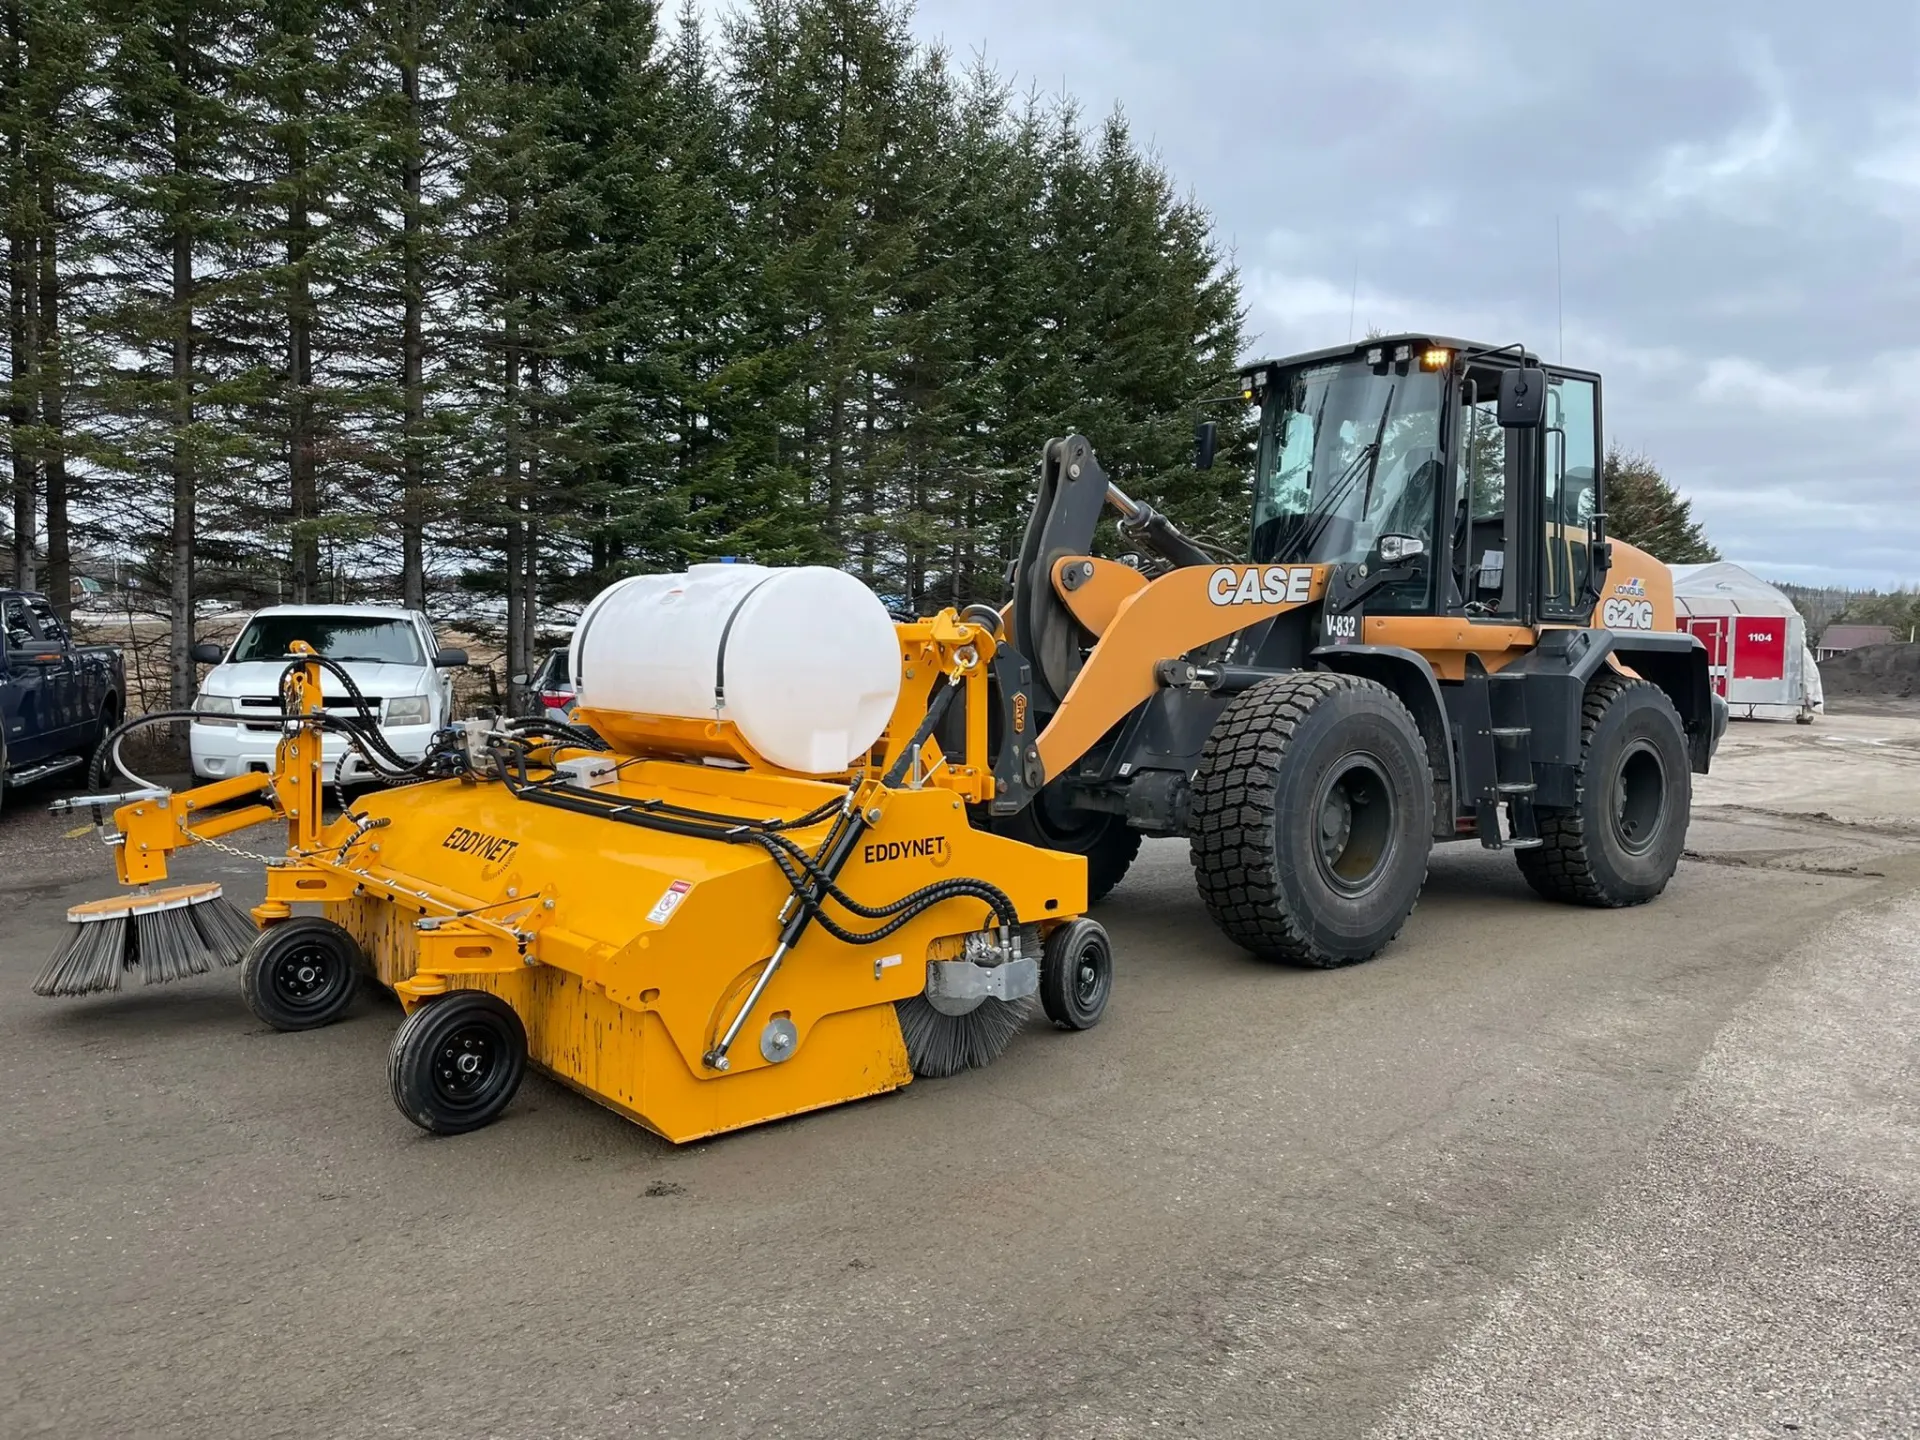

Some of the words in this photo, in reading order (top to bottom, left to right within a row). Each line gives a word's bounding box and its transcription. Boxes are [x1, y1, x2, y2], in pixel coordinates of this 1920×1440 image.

[1207, 566, 1313, 606] CASE
[1614, 585, 1645, 596] LONGUS
[1326, 614, 1356, 637] V-832
[1603, 597, 1653, 630] 621G
[1748, 633, 1772, 642] 1104
[442, 826, 519, 863] EDDYNET
[864, 836, 945, 863] EDDYNET
